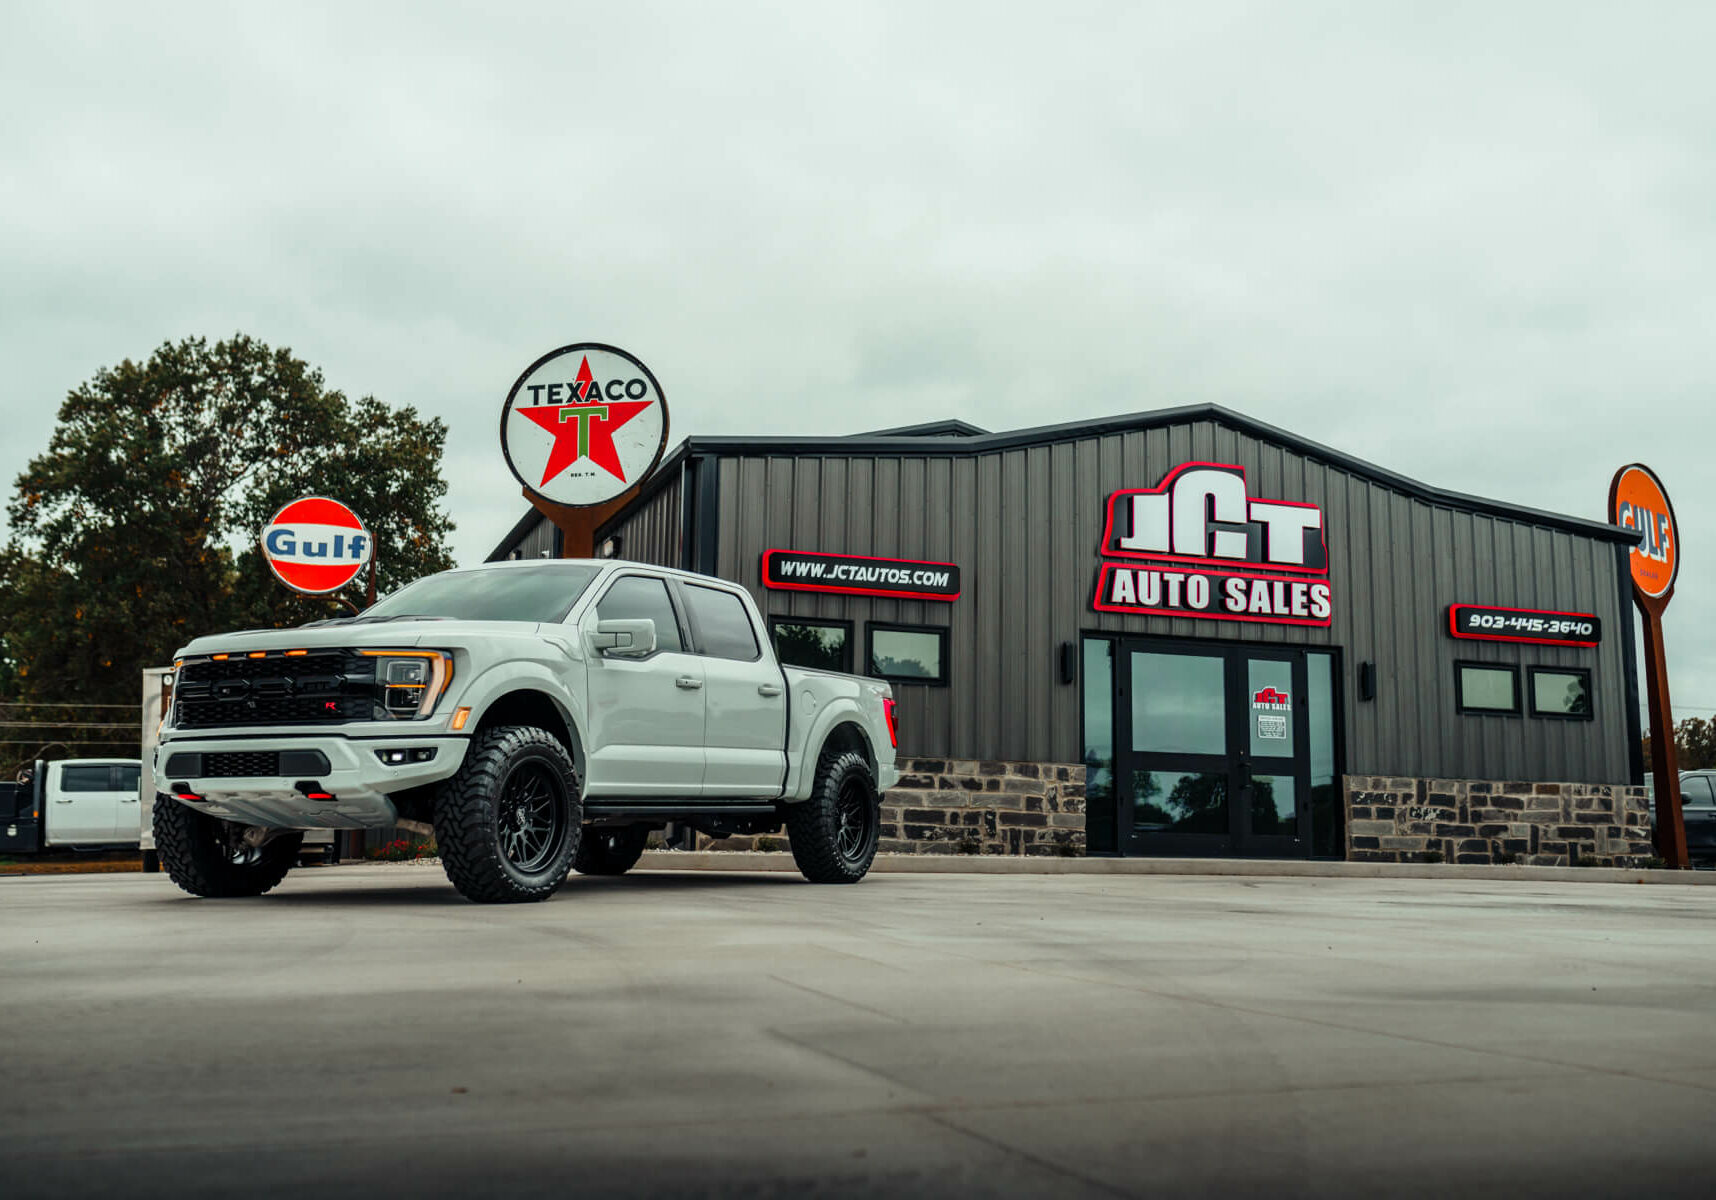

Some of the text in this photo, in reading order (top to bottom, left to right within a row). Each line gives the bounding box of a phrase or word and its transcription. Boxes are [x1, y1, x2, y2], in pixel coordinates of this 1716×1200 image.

[527, 378, 647, 406] TEXACO
[1120, 470, 1320, 564] JCT
[266, 528, 367, 559] Gulf
[1618, 500, 1670, 564] GULF
[781, 560, 949, 587] WWW.JCTAUTOS.COM
[1111, 568, 1331, 618] AUTO SALES
[1468, 613, 1593, 636] 903-445-3640
[325, 702, 336, 711] R
[1253, 702, 1270, 710] AUTO
